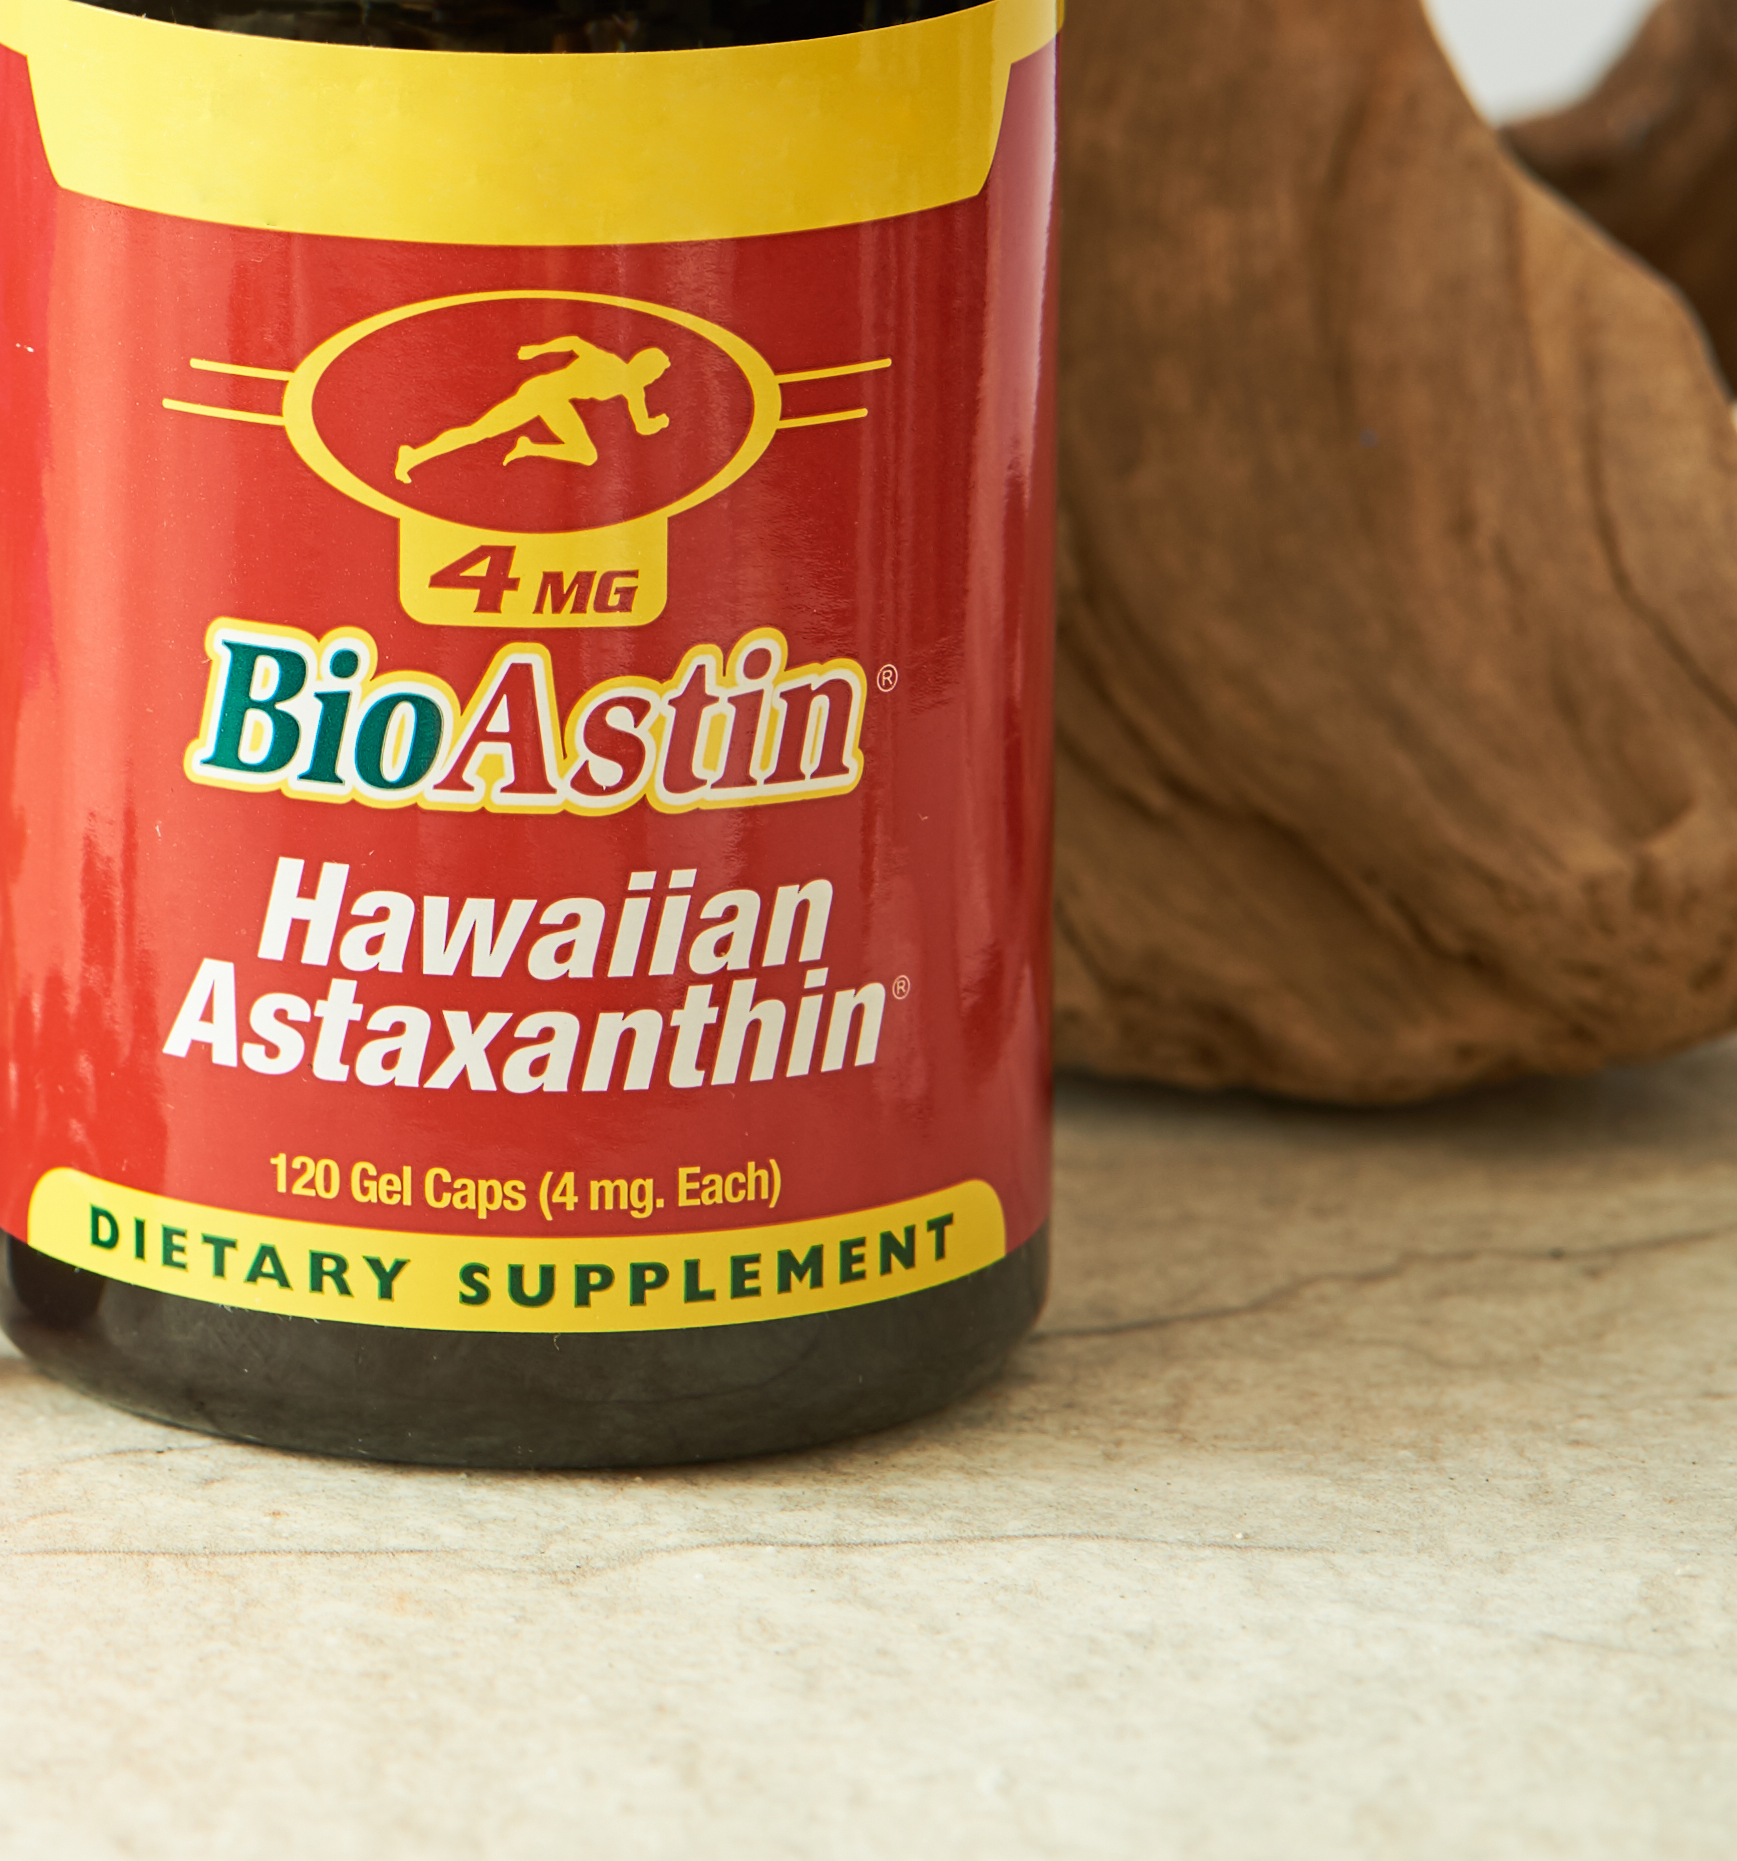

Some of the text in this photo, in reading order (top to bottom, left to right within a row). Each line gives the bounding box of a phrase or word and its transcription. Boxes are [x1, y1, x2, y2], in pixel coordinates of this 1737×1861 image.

[428, 544, 639, 614] 4 MG
[257, 856, 834, 980] Hawaiian
[269, 1153, 783, 1220] 120 Gel Caps (4 mg. Each)
[89, 1204, 954, 1307] DIETARY SUPPLEMENT
